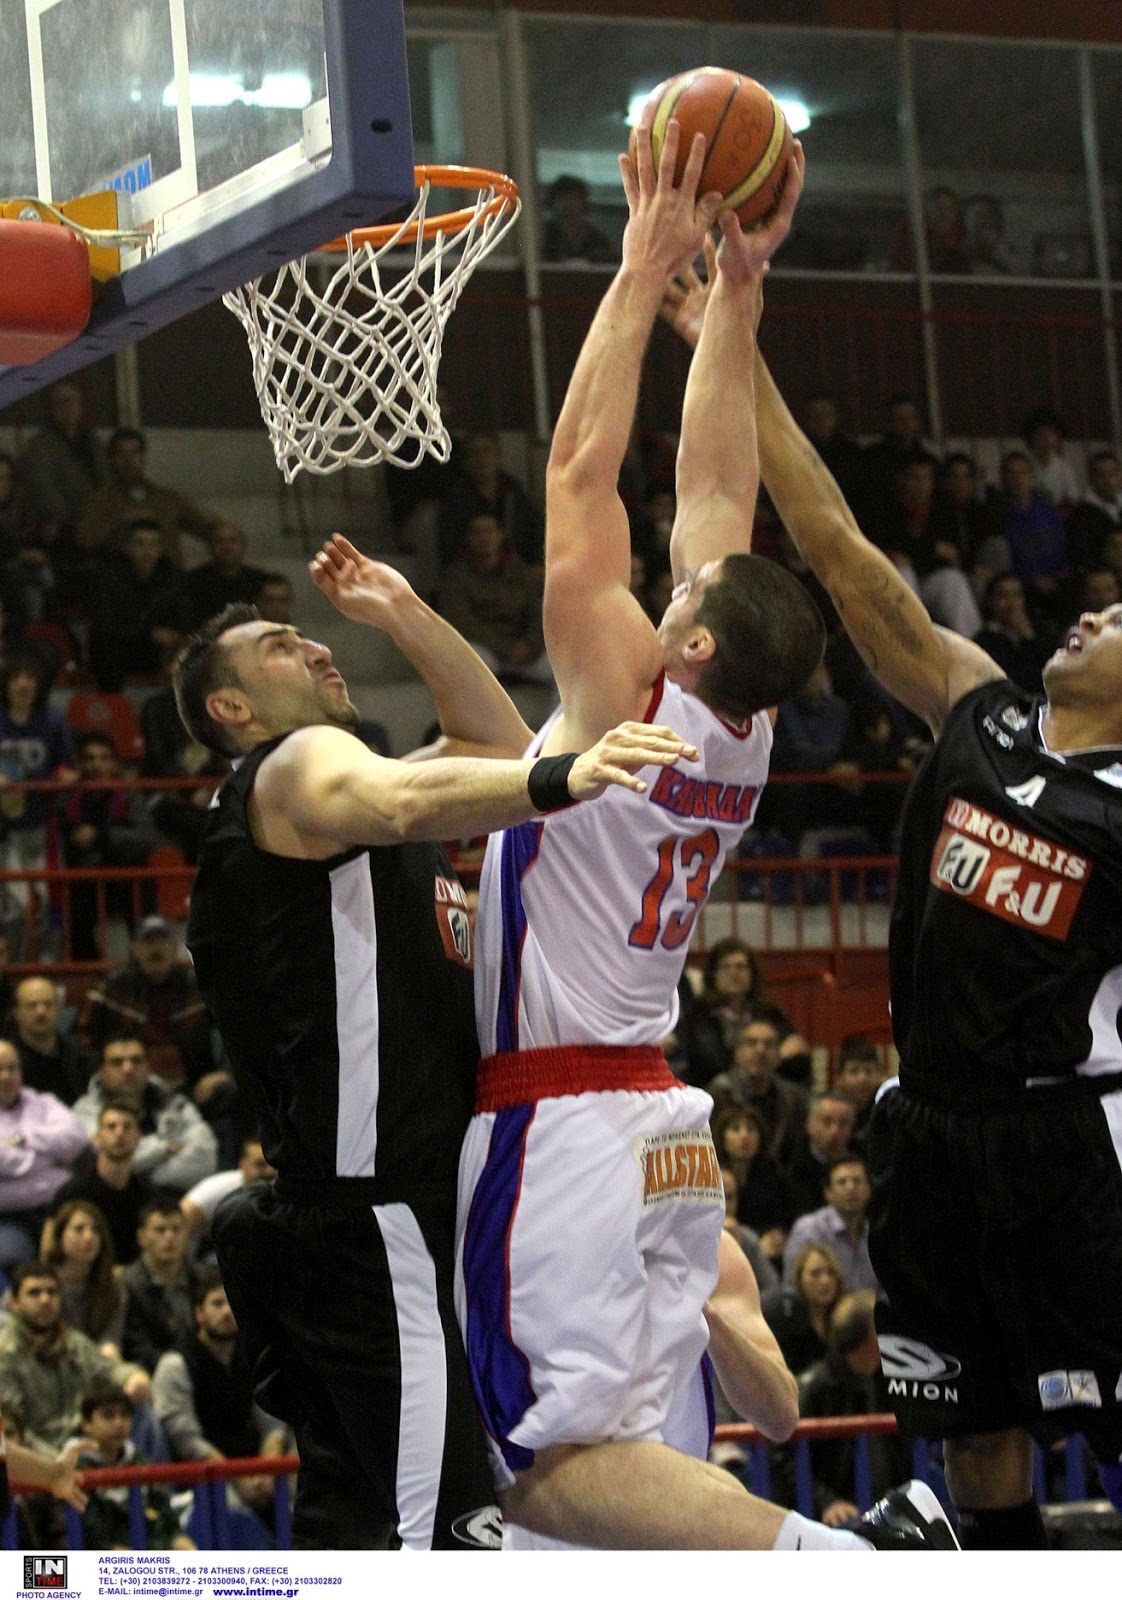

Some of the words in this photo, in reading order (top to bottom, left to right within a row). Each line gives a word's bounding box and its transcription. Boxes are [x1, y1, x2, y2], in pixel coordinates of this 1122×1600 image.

[1005, 774, 1046, 809] 4
[964, 807, 1087, 880] MORRIS
[628, 828, 720, 950] 13
[888, 1378, 959, 1404] MION
